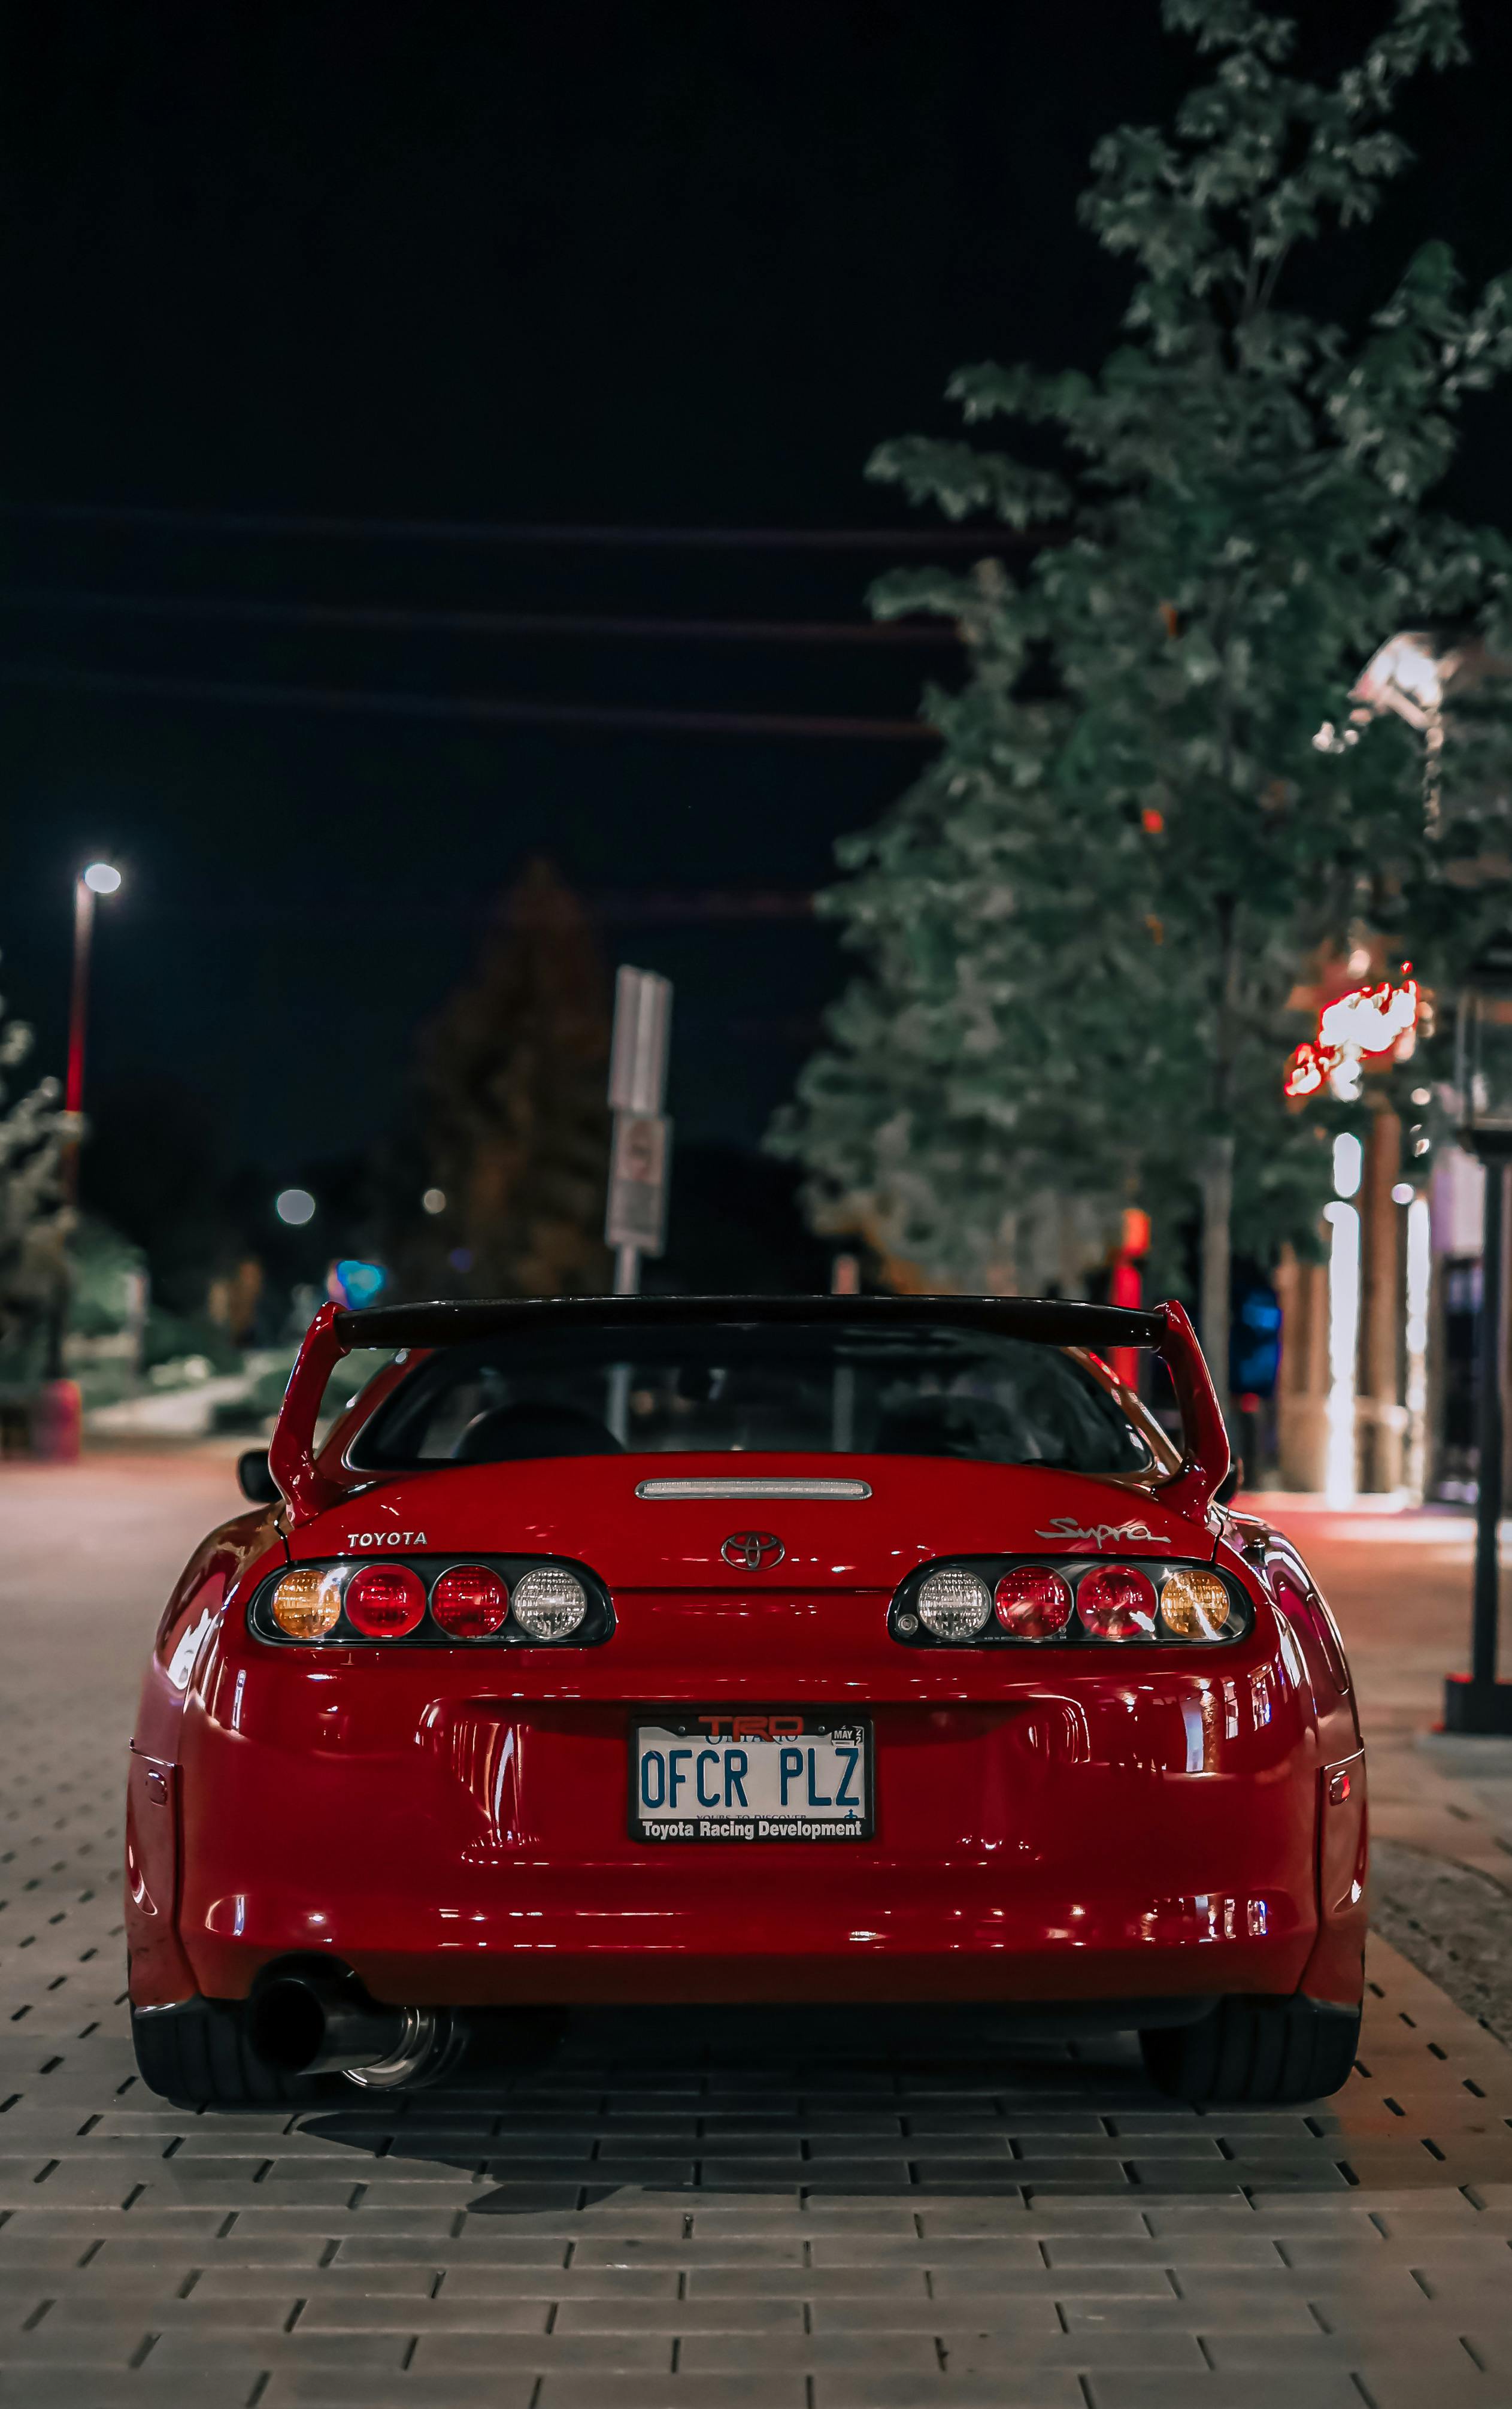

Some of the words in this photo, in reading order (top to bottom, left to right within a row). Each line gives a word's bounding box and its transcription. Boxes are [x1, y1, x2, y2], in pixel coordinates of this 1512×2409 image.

[347, 1532, 428, 1548] TOYOTA
[1035, 1517, 1171, 1549] Supra
[698, 1716, 804, 1742] TRD
[834, 1730, 853, 1739] MAY
[641, 1749, 749, 1808] OFCR
[780, 1748, 860, 1806] PLZ
[643, 1821, 694, 1840] Toyota
[700, 1821, 755, 1840] Racing
[759, 1821, 862, 1839] Development
